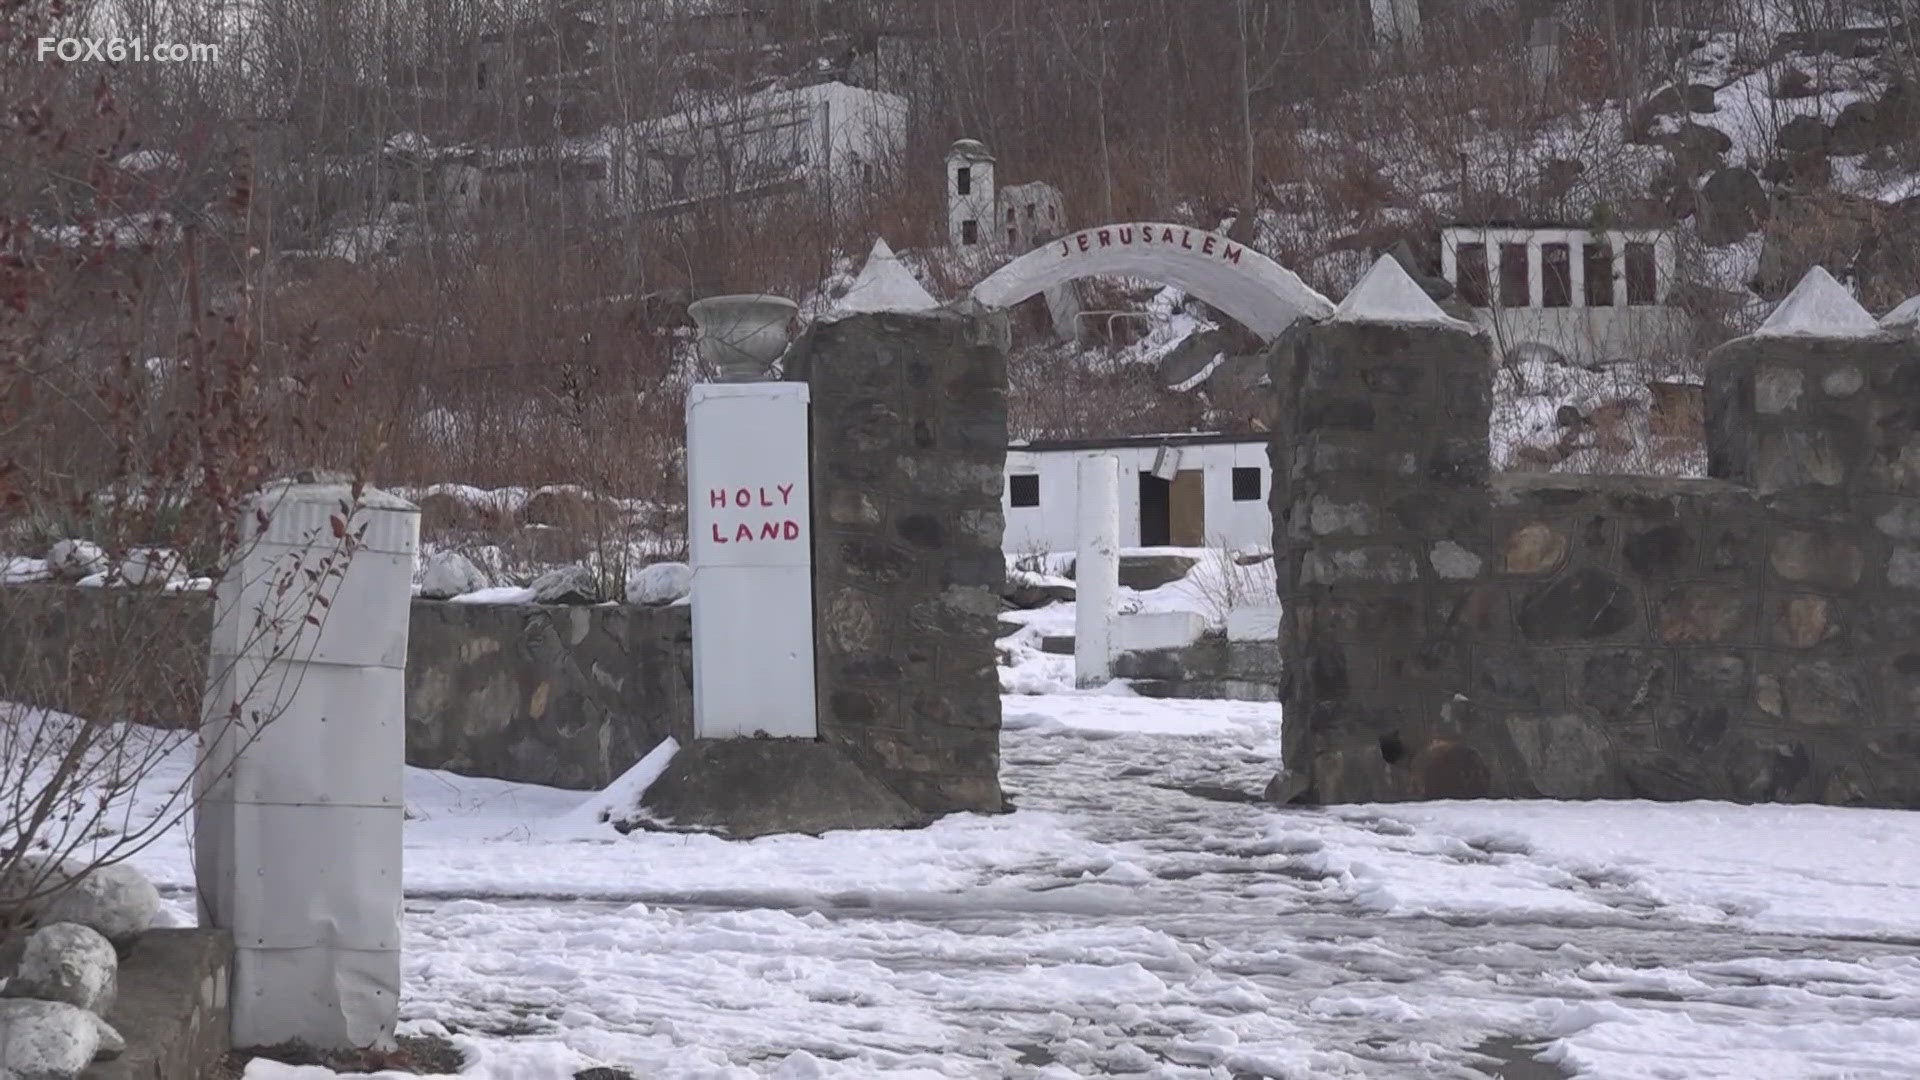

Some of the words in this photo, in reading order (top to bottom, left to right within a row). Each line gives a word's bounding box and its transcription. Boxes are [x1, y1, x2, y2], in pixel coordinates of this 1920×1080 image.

[1061, 226, 1243, 265] JERUSALEM
[710, 484, 793, 509] HOLY
[712, 520, 799, 543] LAND
